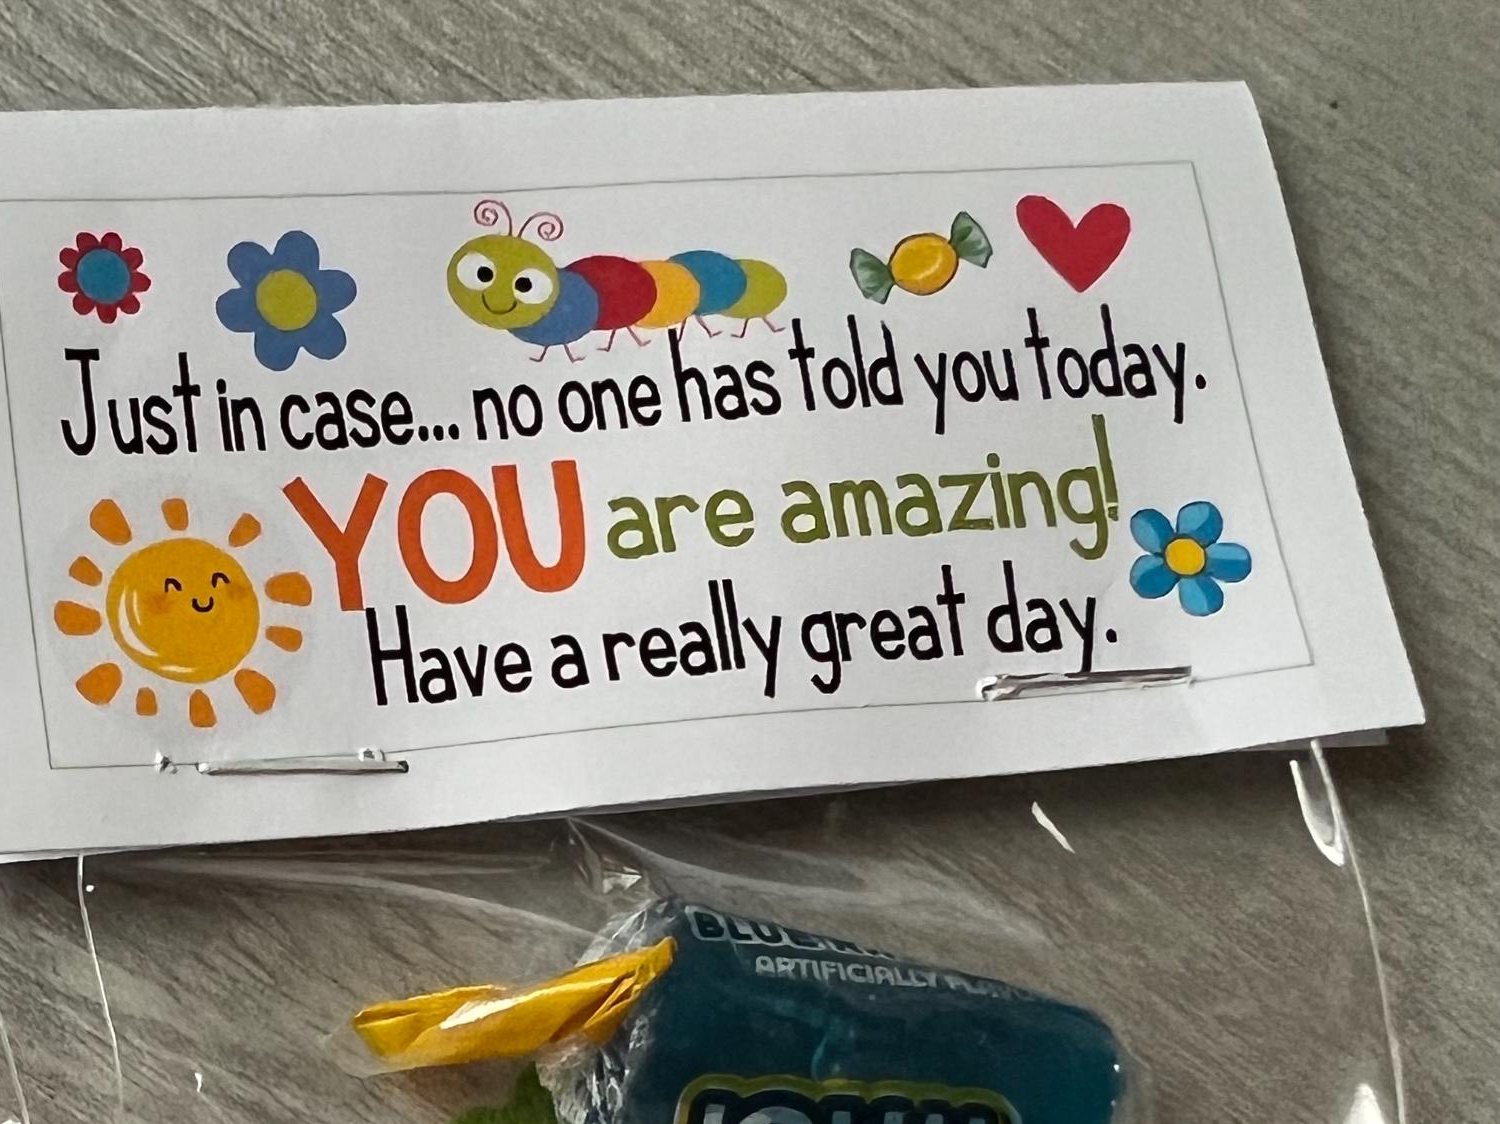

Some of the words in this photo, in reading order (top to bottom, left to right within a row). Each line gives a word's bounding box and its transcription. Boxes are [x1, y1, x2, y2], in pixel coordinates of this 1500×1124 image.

[61, 348, 201, 455] Just
[217, 379, 266, 451] in
[280, 389, 459, 450] case...
[473, 384, 543, 440] no
[558, 375, 661, 432] one
[668, 328, 781, 422] has
[788, 315, 903, 411] told
[914, 349, 1019, 435] you
[1024, 304, 1206, 424] today.
[284, 461, 584, 610] YOU
[608, 490, 753, 558] are
[782, 415, 1117, 559] amazing!
[366, 605, 532, 705] Have
[551, 635, 589, 688] a
[603, 579, 781, 698] really
[802, 565, 965, 694] great
[987, 560, 1118, 673] day.
[754, 955, 938, 988] ARTIFICIALLY
